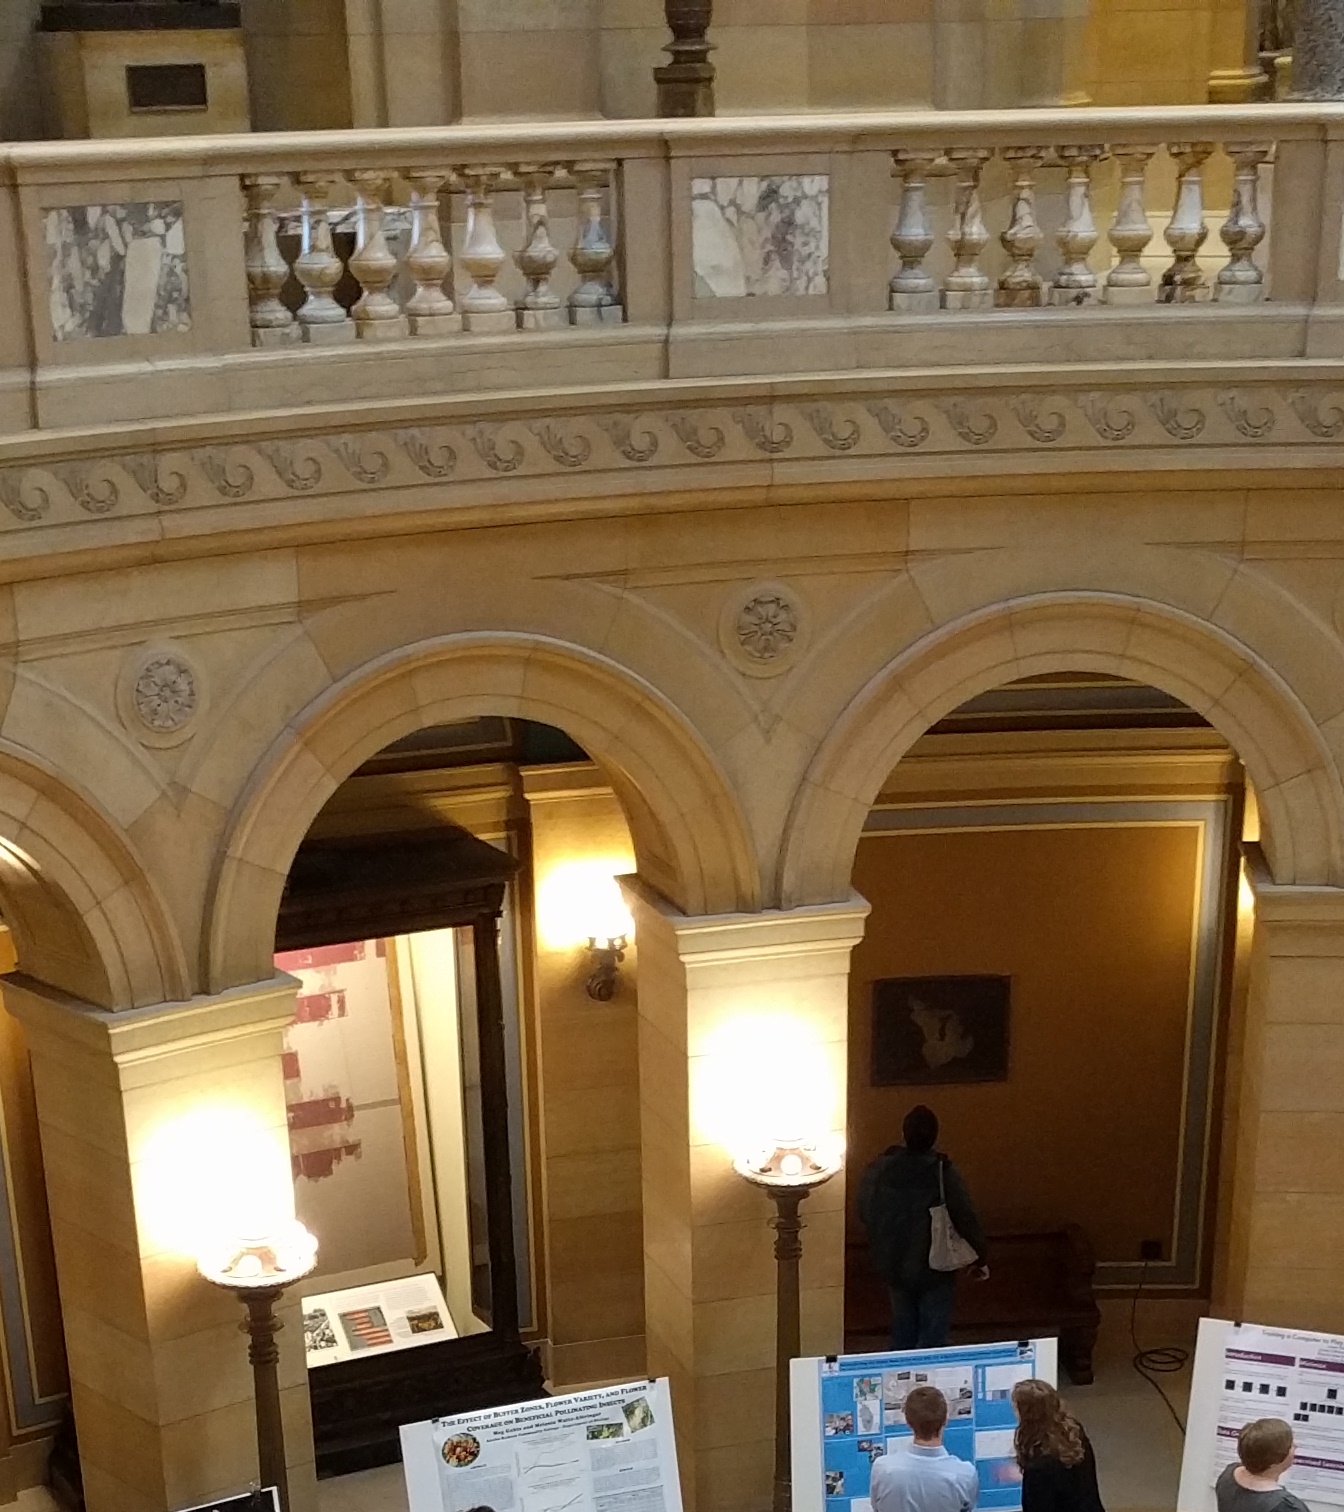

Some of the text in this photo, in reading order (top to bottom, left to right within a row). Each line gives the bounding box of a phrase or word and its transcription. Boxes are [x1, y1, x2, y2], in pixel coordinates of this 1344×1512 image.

[457, 1416, 482, 1425] EFFECT
[493, 1409, 519, 1418] BUFFER
[545, 1398, 573, 1408] FLOWER
[620, 1385, 647, 1395] FLOWER
[514, 1412, 553, 1424] BENEFICIAL
[555, 1403, 598, 1416] POLLINATING
[599, 1398, 626, 1408] INSECTS
